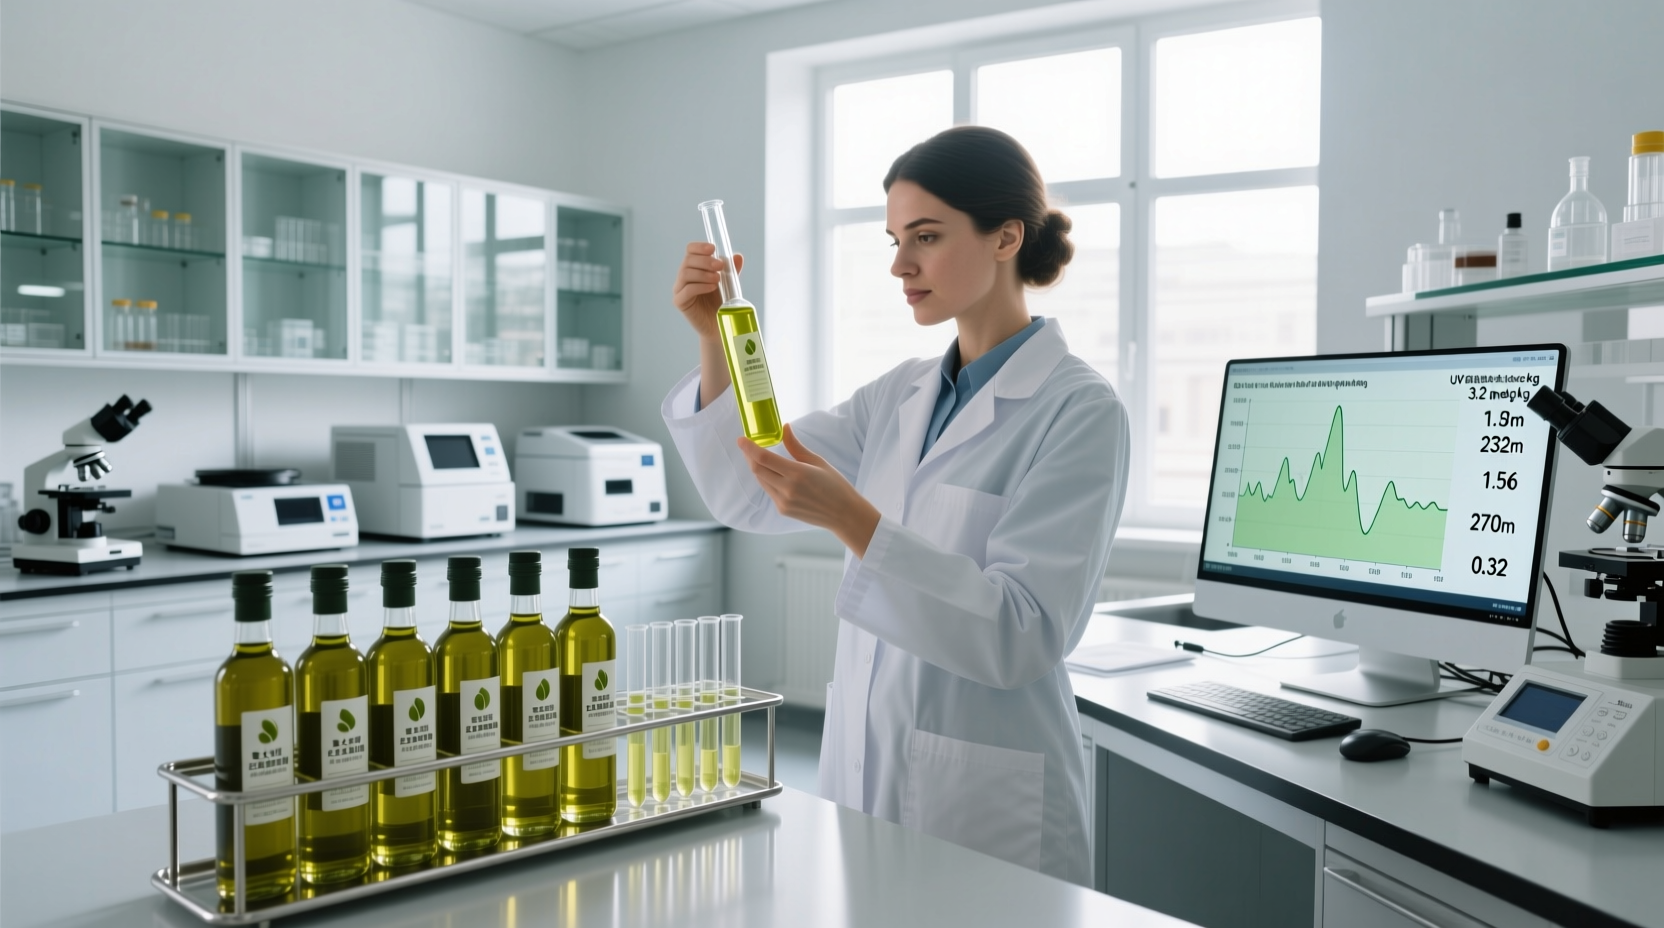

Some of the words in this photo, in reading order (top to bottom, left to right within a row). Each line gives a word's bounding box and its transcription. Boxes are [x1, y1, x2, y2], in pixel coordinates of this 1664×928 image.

[1468, 386, 1487, 400] 3.2
[1480, 435, 1523, 453] 232m
[1483, 471, 1518, 490] 1.56
[1470, 513, 1515, 534] 270m
[1471, 555, 1508, 577] 0.32
